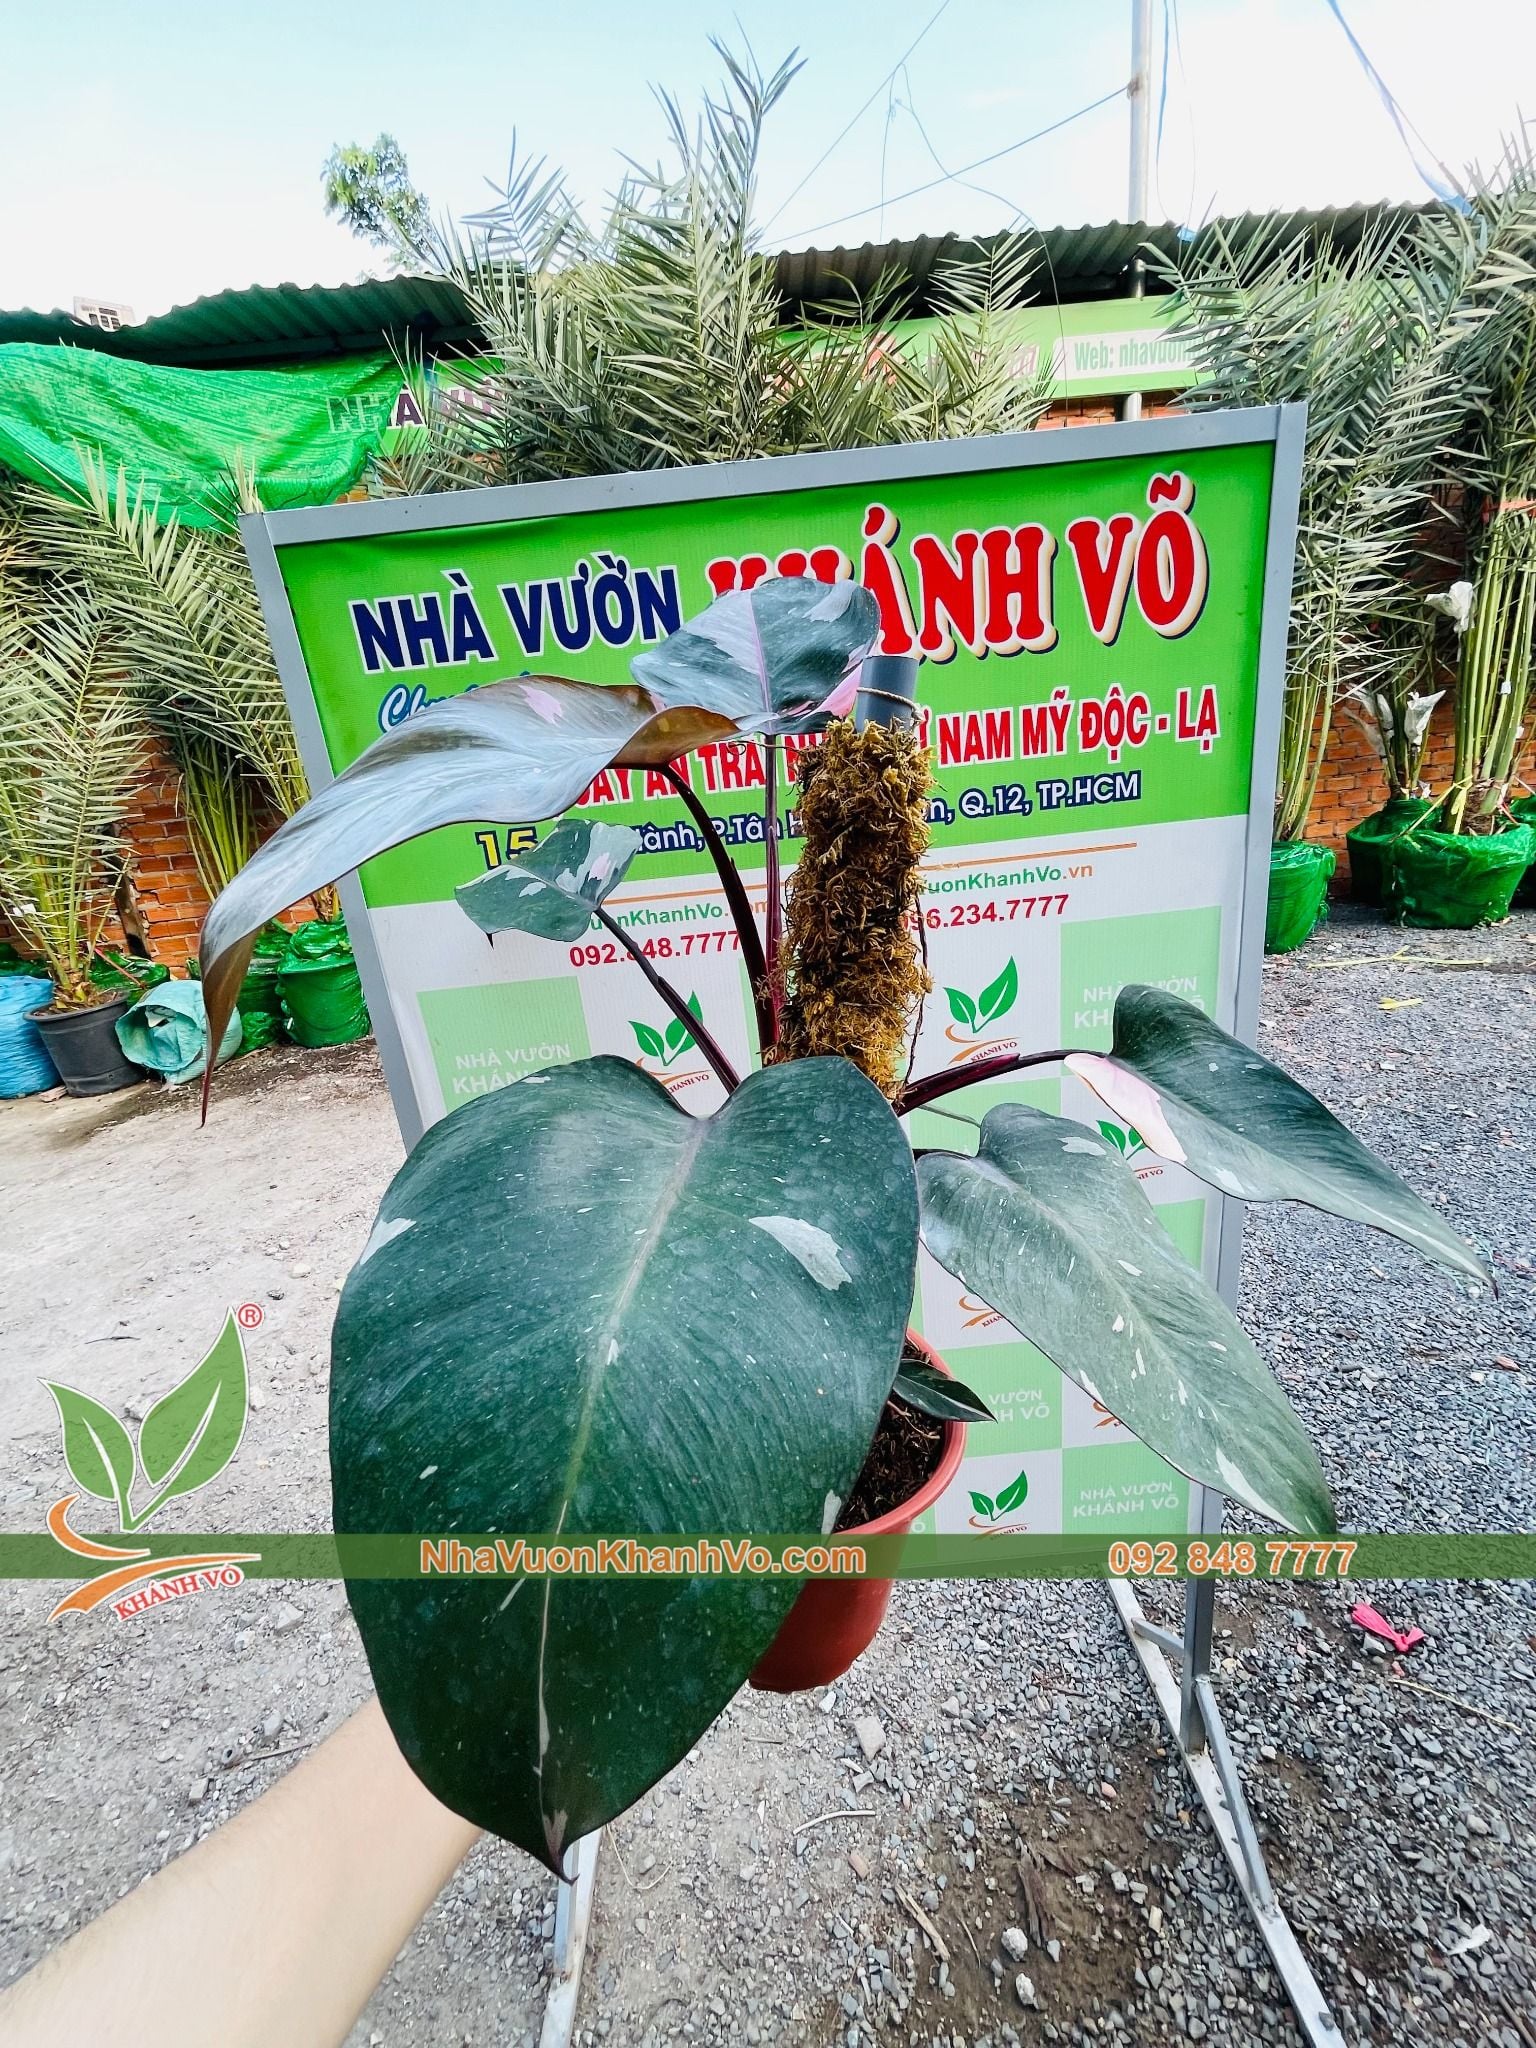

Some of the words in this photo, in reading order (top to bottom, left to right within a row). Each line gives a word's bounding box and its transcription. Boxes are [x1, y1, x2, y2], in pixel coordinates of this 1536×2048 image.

[1074, 340, 1113, 371] Web:
[1119, 338, 1198, 368] nhavuon
[350, 570, 497, 672] NHÀ
[501, 552, 682, 655] VƯỜN
[706, 503, 1057, 663] ÁNH
[1065, 470, 1209, 645] VÕ
[939, 708, 1013, 767] NAM
[1021, 686, 1074, 759] MỸ
[1079, 683, 1150, 763] ĐỘC
[1176, 684, 1220, 754] LẠ
[961, 784, 1031, 819] Q.12,
[1037, 771, 1141, 809] TP.HCM
[904, 894, 1069, 931] 96.234.7777
[455, 1048, 502, 1069] NHÀ
[505, 1042, 571, 1064] VƯỜN
[452, 1069, 531, 1094] KHÁN
